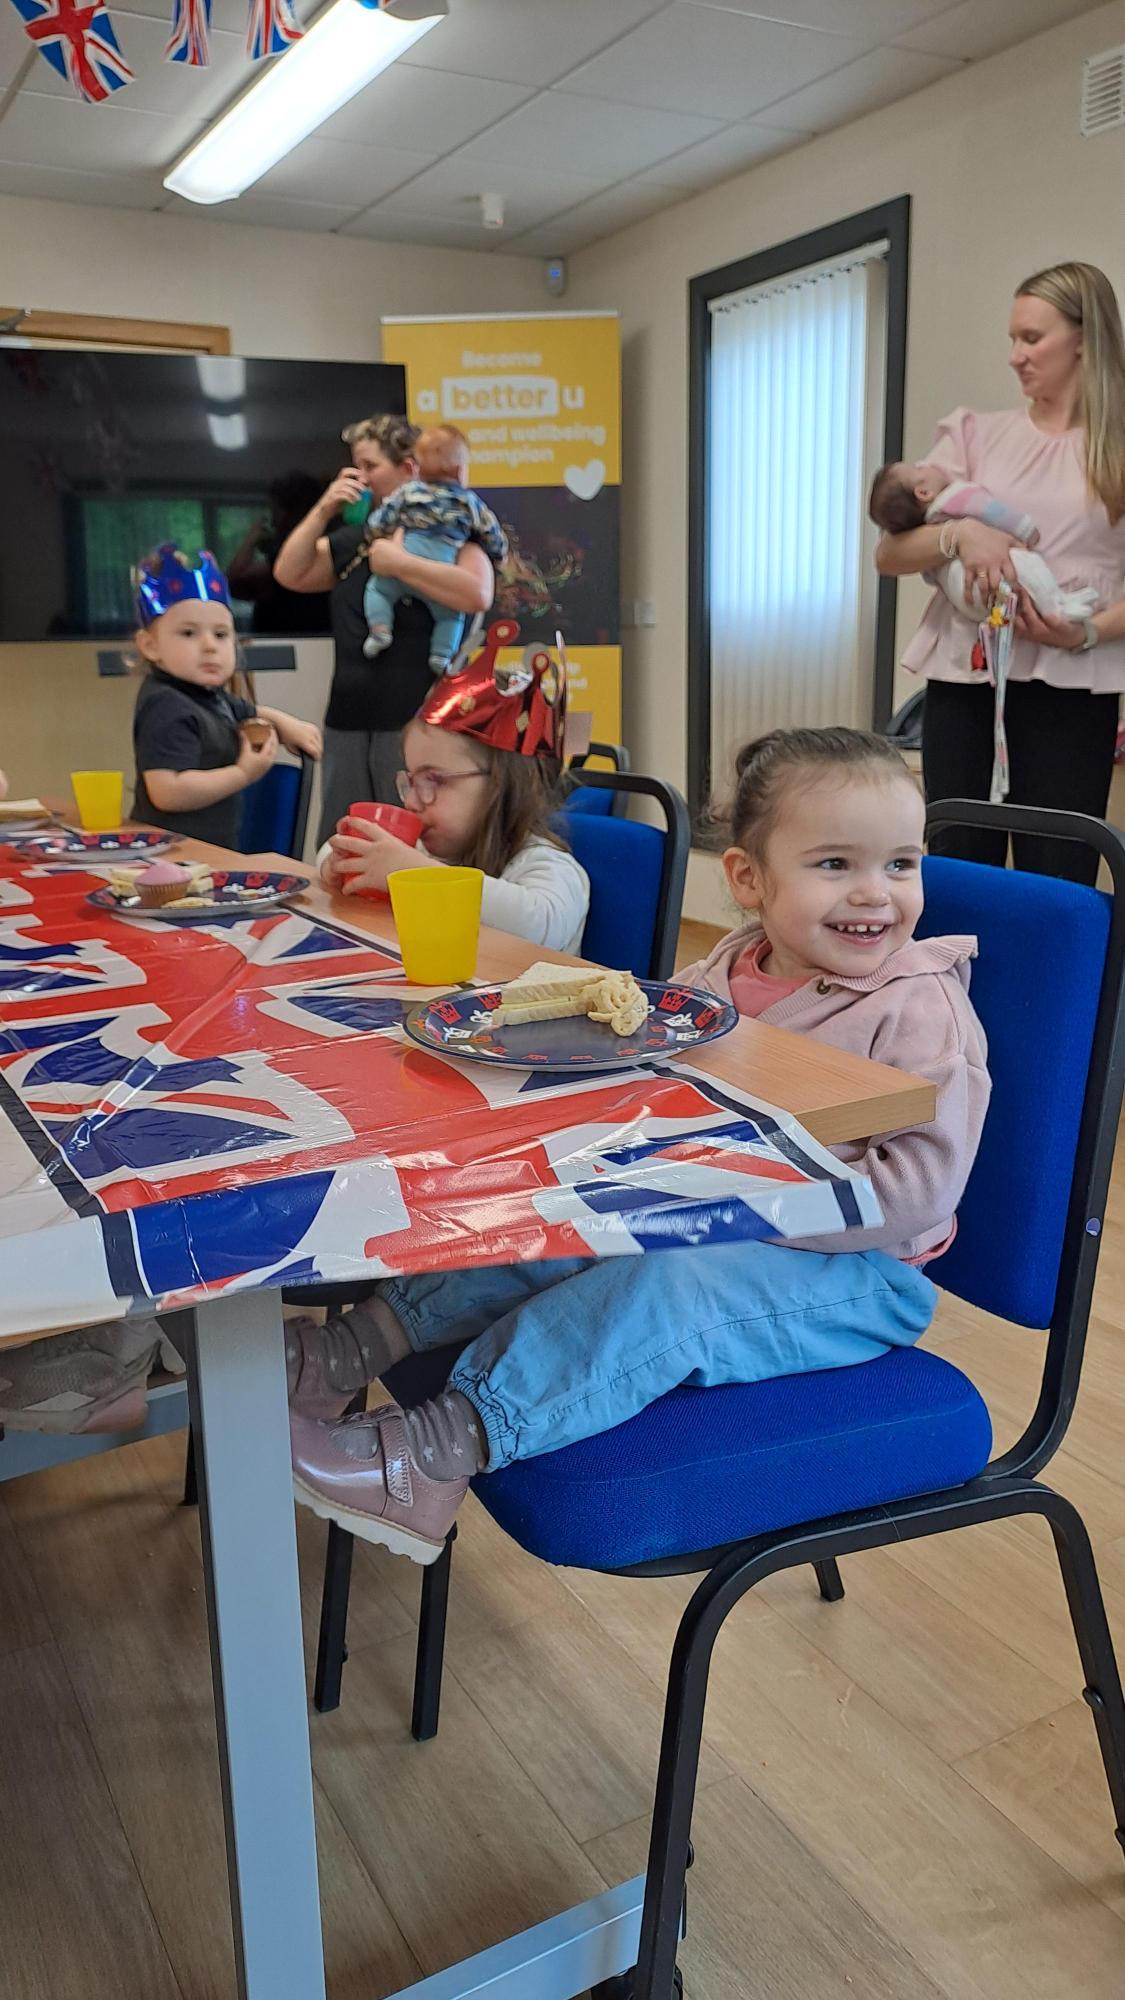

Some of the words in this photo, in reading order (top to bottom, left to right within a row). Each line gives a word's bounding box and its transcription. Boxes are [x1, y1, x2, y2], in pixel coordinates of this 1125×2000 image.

[416, 390, 437, 413] a
[452, 384, 548, 411] better
[562, 385, 585, 409] u
[468, 425, 508, 444] and
